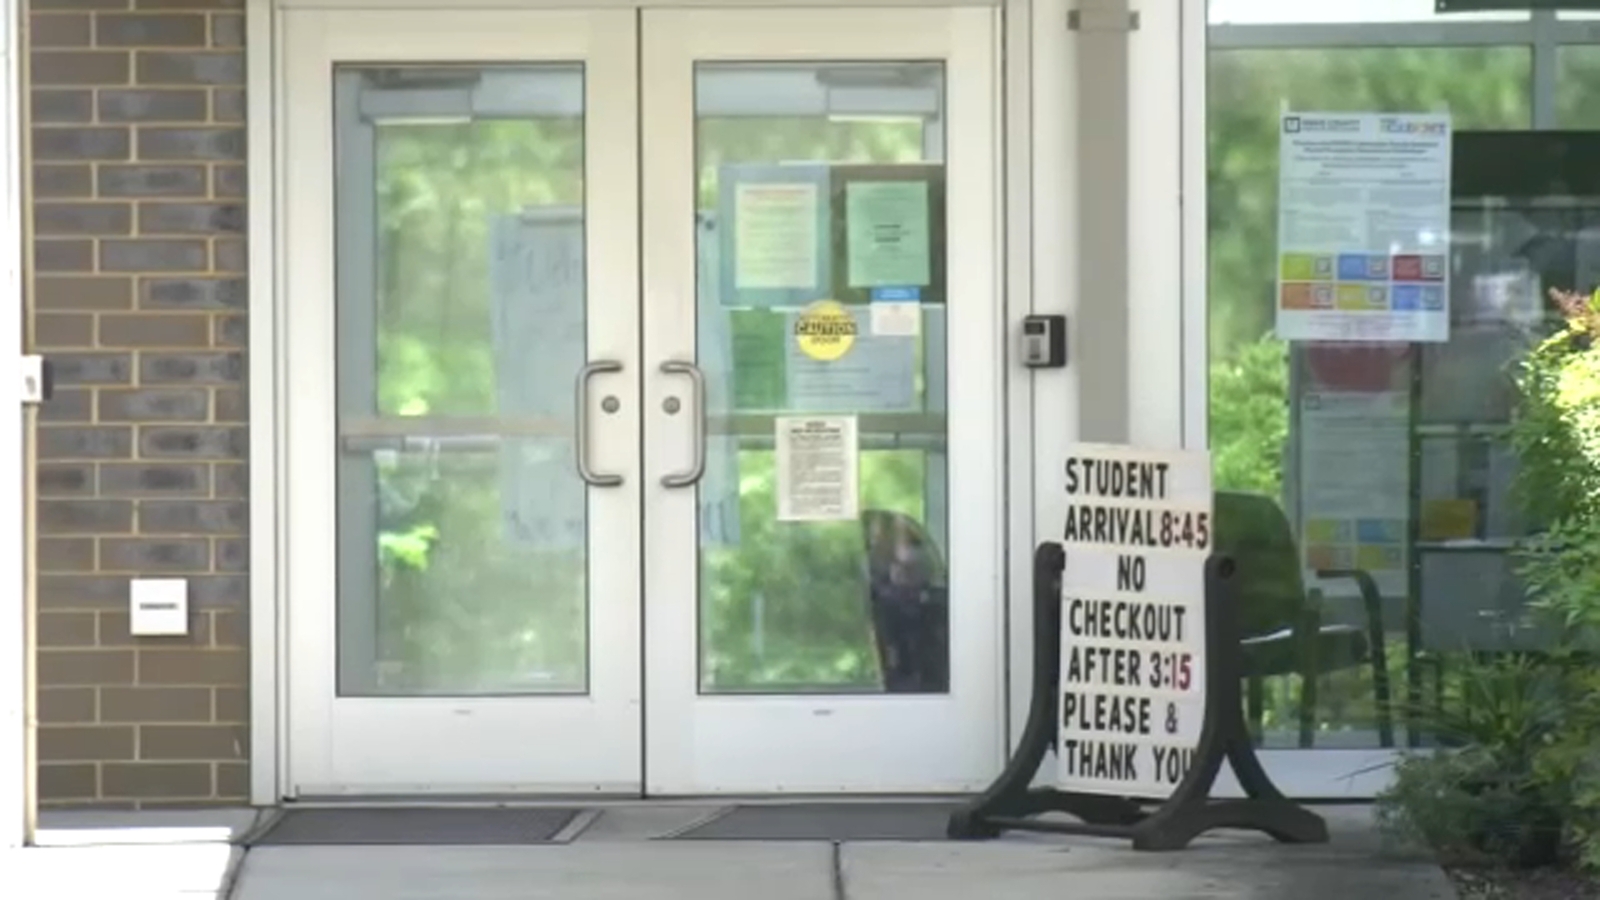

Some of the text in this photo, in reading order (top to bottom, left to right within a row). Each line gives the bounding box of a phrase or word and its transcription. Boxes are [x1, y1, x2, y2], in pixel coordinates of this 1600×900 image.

[796, 320, 856, 335] CAUTION
[1065, 457, 1169, 500] STUDENT
[1064, 504, 1208, 549] ARRIVAL 8:45
[1117, 554, 1146, 592] NO
[1069, 599, 1186, 642] CHECKOUT
[1068, 646, 1192, 690] AFTER 3:15
[1063, 692, 1178, 734] PLEASE &
[1065, 739, 1137, 780] THANK
